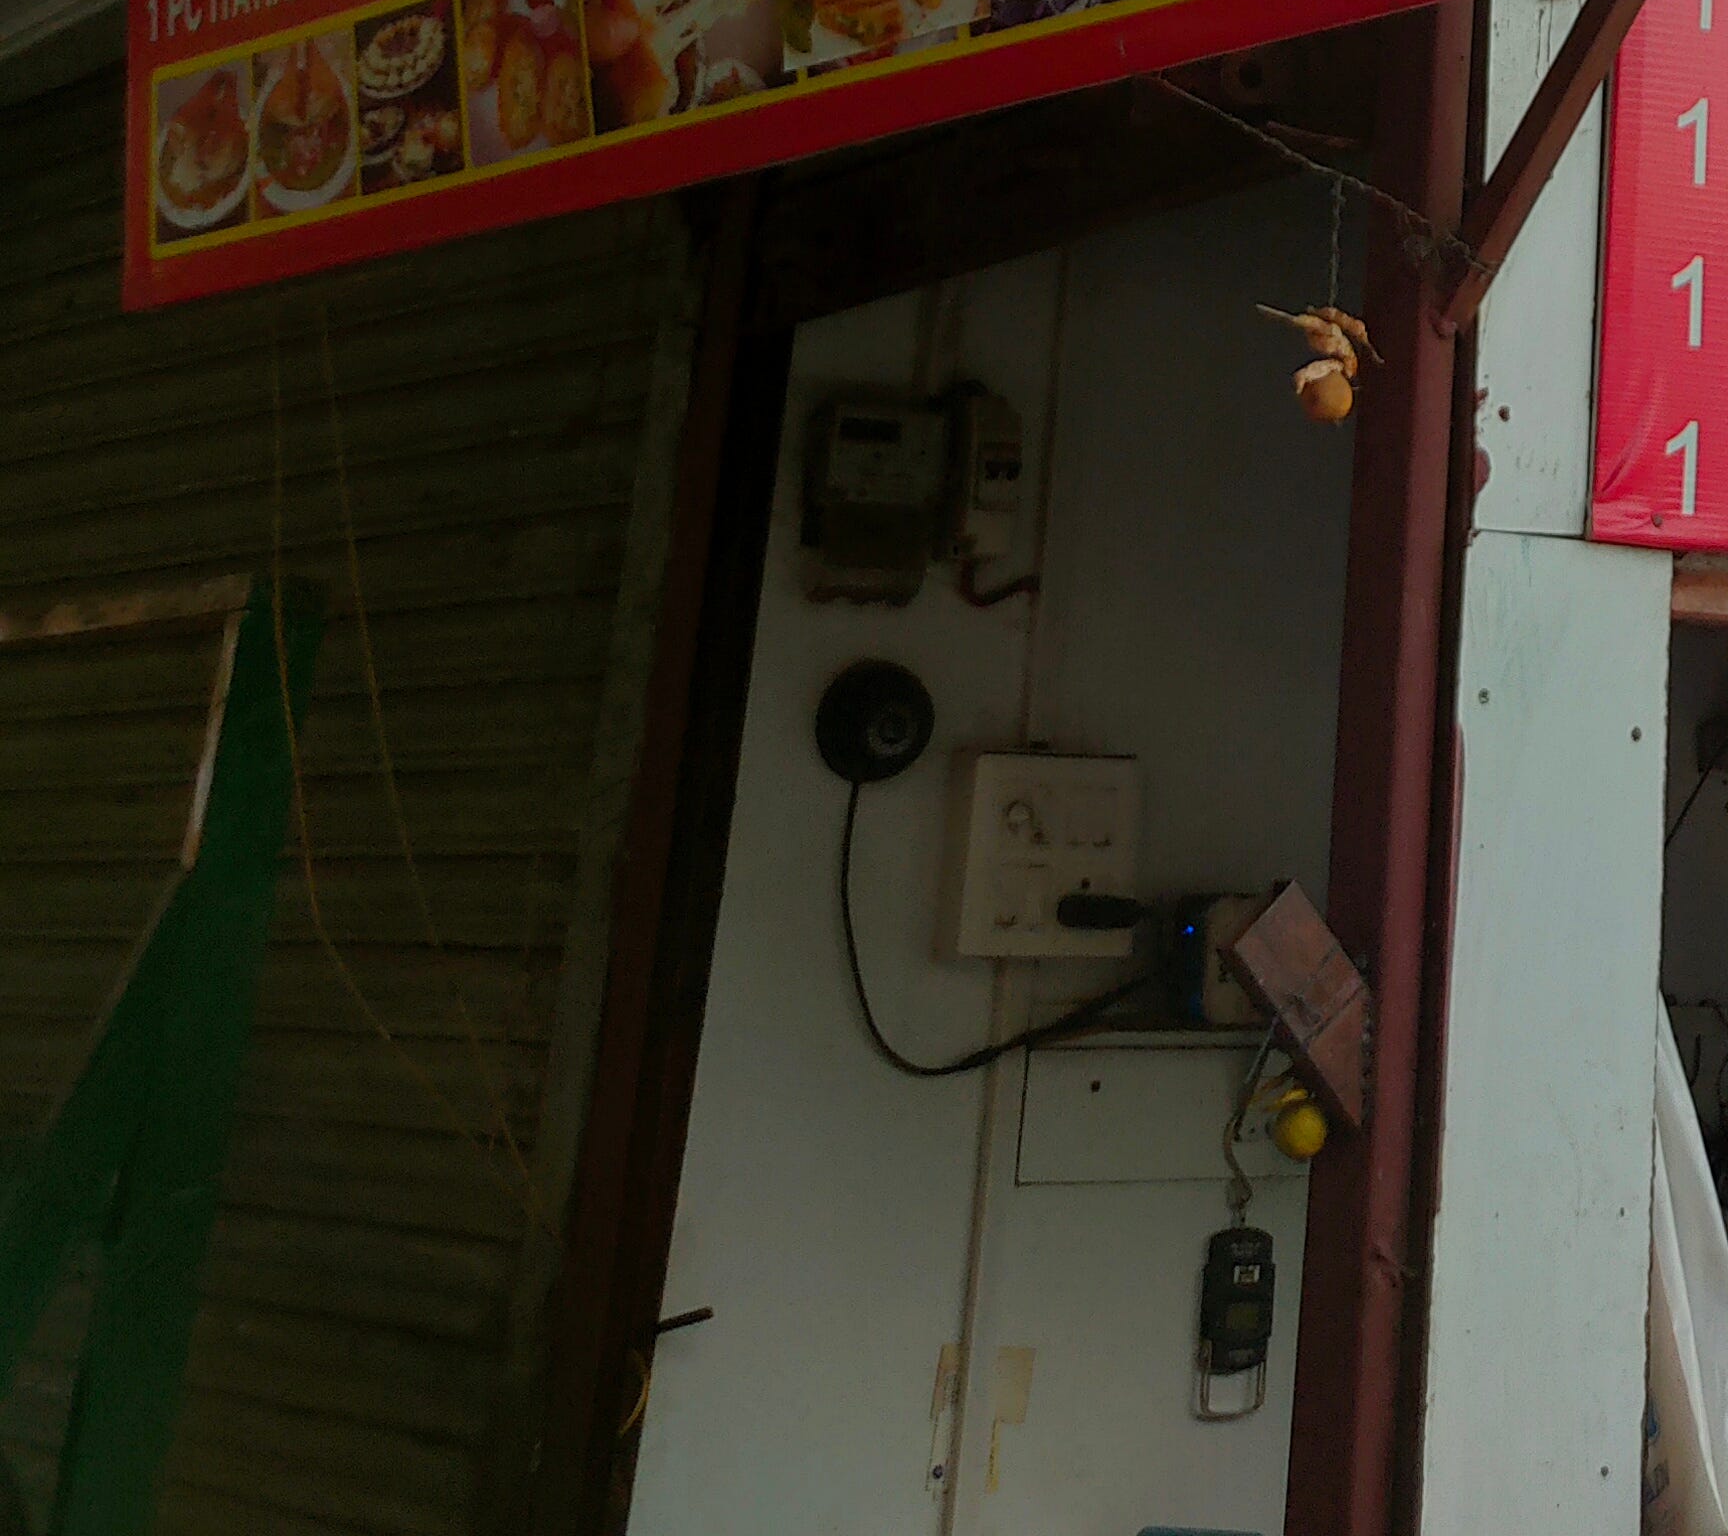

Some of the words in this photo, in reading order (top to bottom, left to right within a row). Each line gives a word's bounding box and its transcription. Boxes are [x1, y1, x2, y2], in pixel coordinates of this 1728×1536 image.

[1677, 98, 1708, 185] 1
[1672, 257, 1703, 347] 1
[1666, 421, 1698, 515] 1
